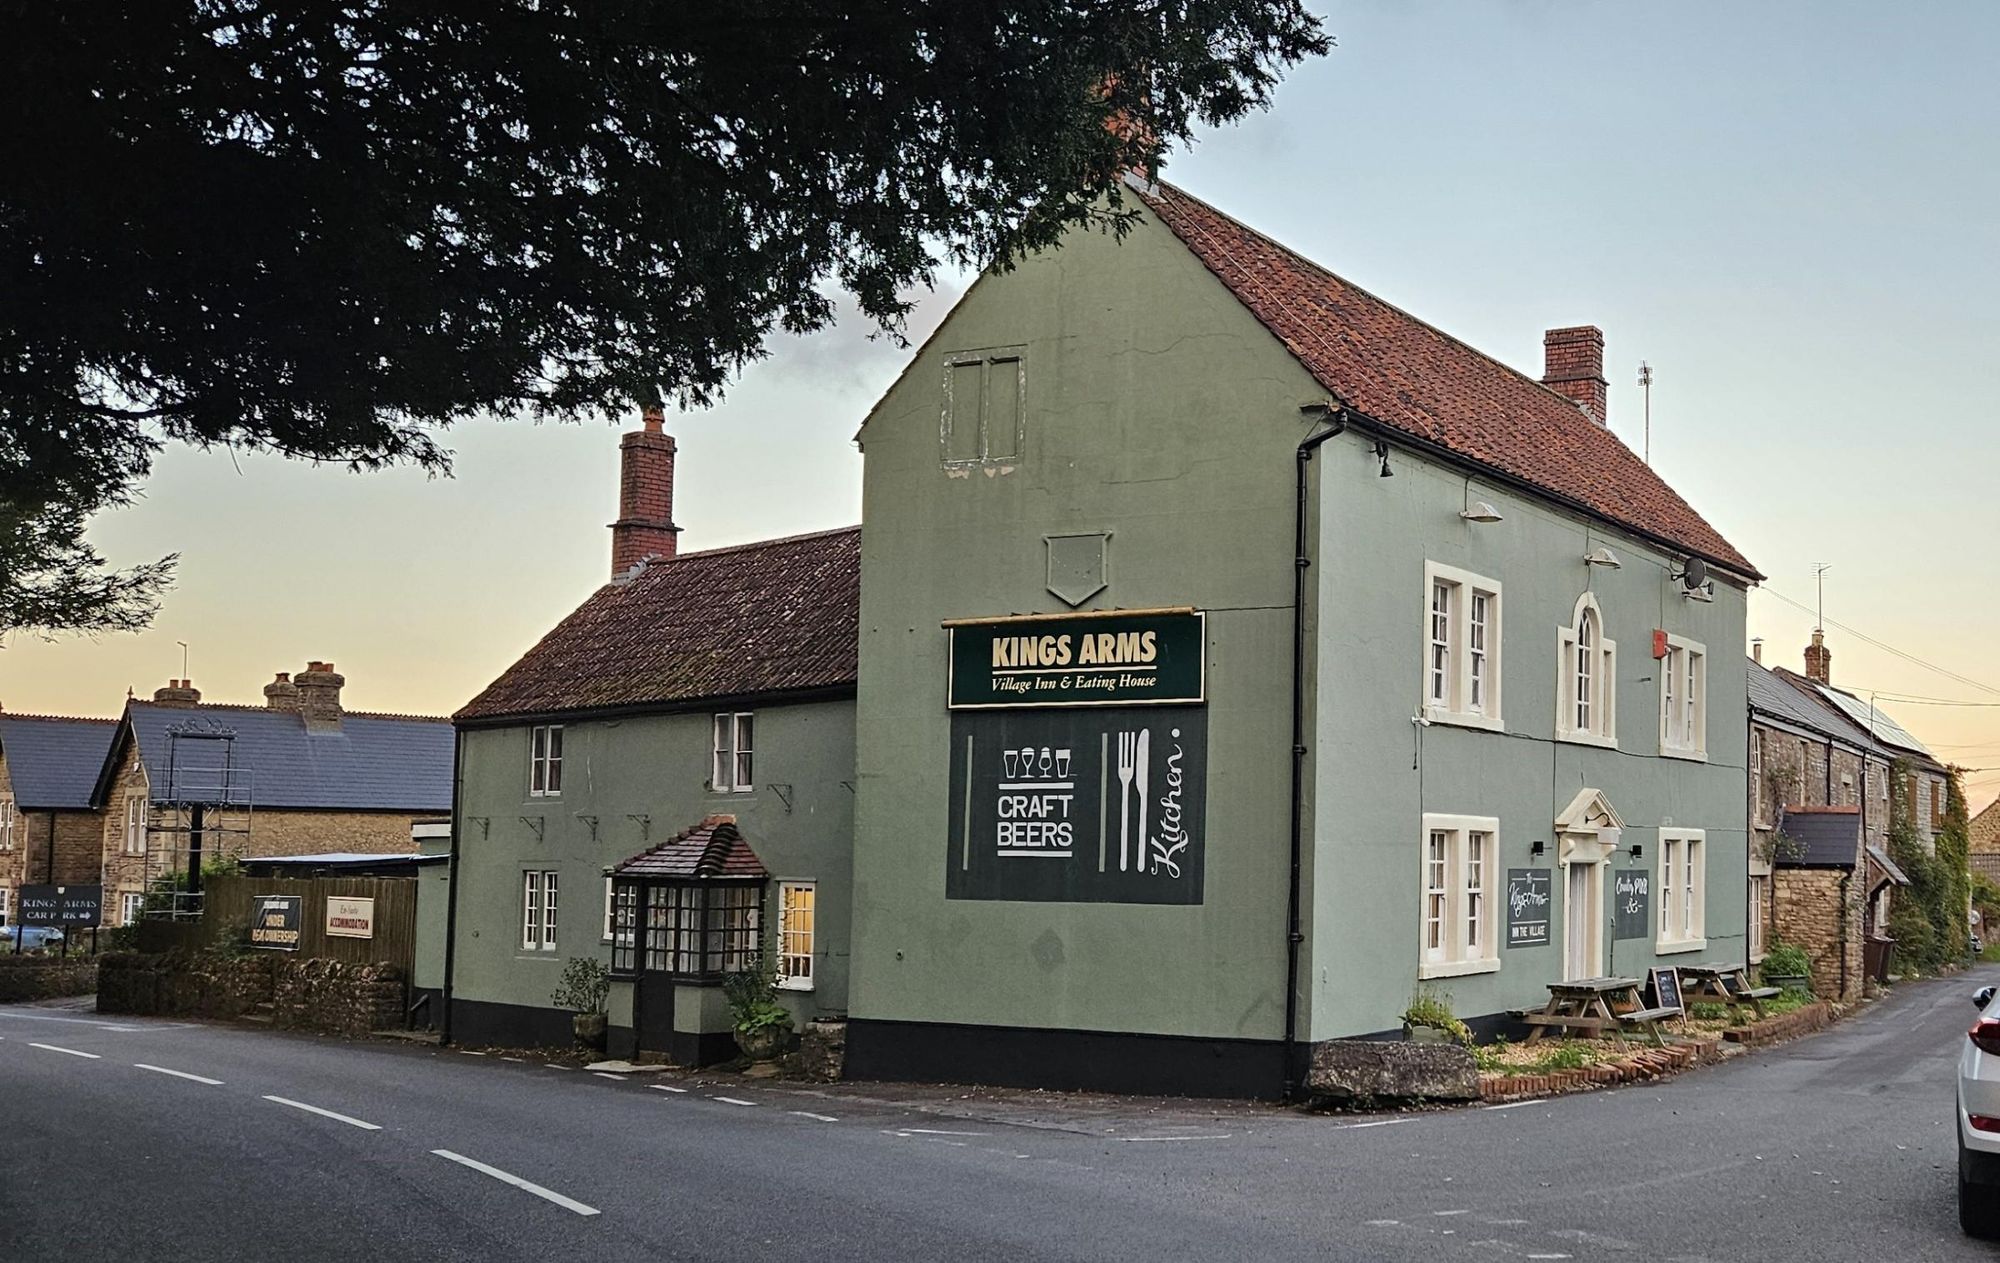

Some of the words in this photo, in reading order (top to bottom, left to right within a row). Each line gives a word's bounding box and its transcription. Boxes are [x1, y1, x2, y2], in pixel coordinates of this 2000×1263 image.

[991, 634, 1072, 668] KINGS
[1078, 631, 1157, 665] ARMS
[991, 676, 1032, 694] Village
[1034, 677, 1056, 689] Inn
[1060, 677, 1072, 689] &
[1075, 674, 1115, 692] Eating
[1119, 673, 1157, 688] House
[998, 795, 1074, 818] CRAFT
[997, 822, 1073, 847] BEERS
[63, 899, 97, 908] ARMS
[26, 911, 47, 920] CAR
[50, 911, 76, 920] PRK
